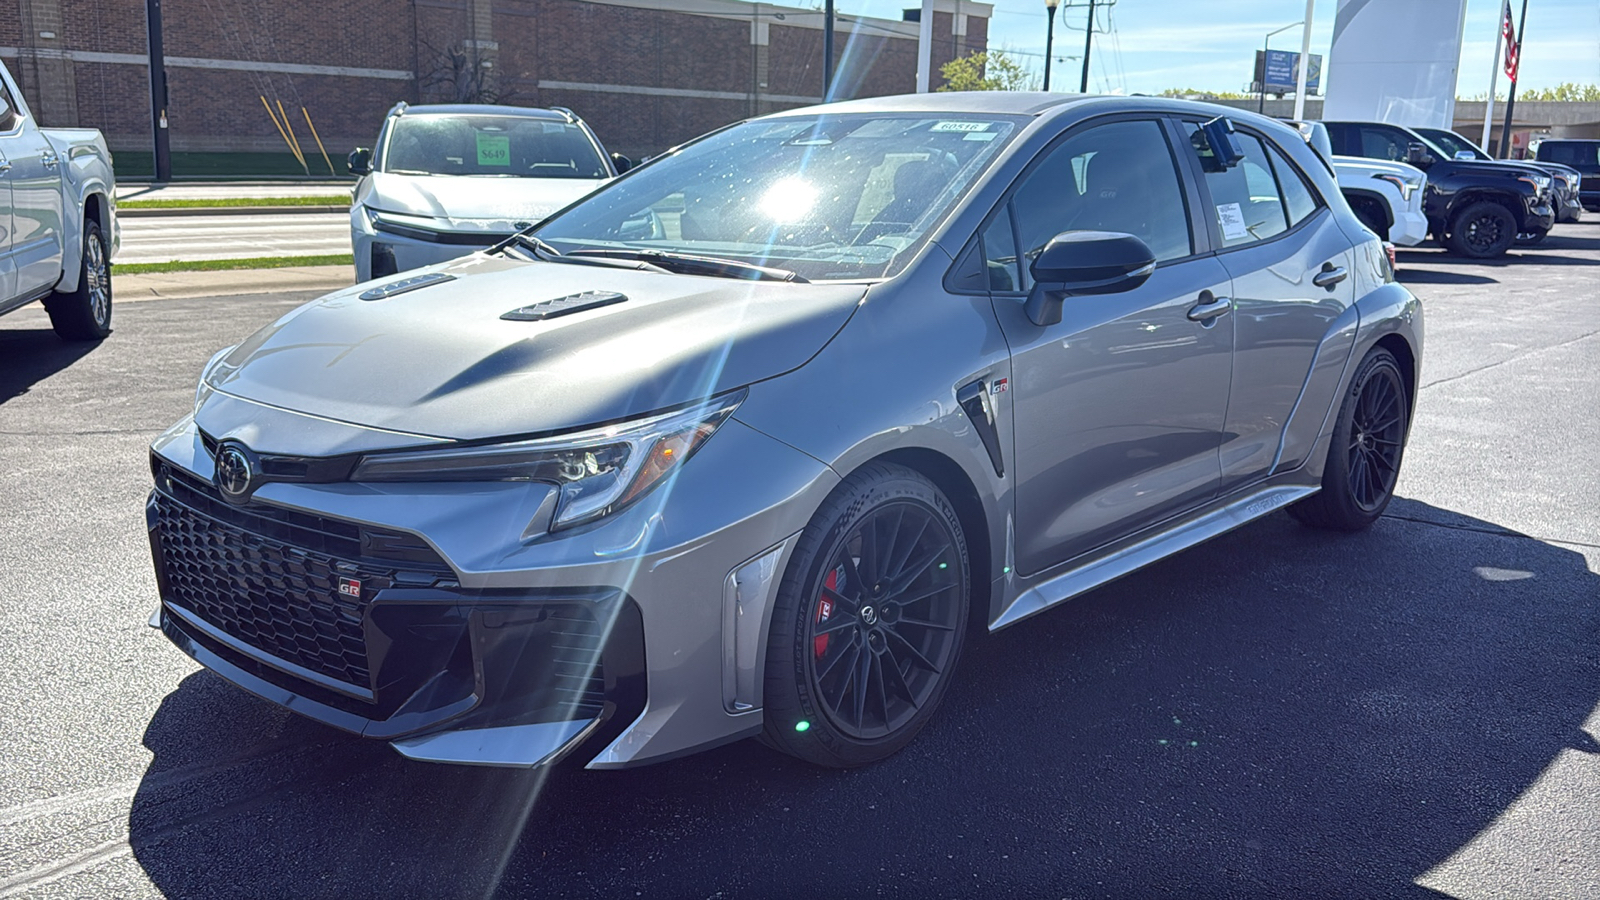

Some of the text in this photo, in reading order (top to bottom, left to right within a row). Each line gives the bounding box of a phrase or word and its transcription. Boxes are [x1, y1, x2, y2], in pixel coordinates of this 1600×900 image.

[481, 149, 506, 159] $649
[943, 506, 968, 564] MICHELIN
[340, 582, 360, 596] GR
